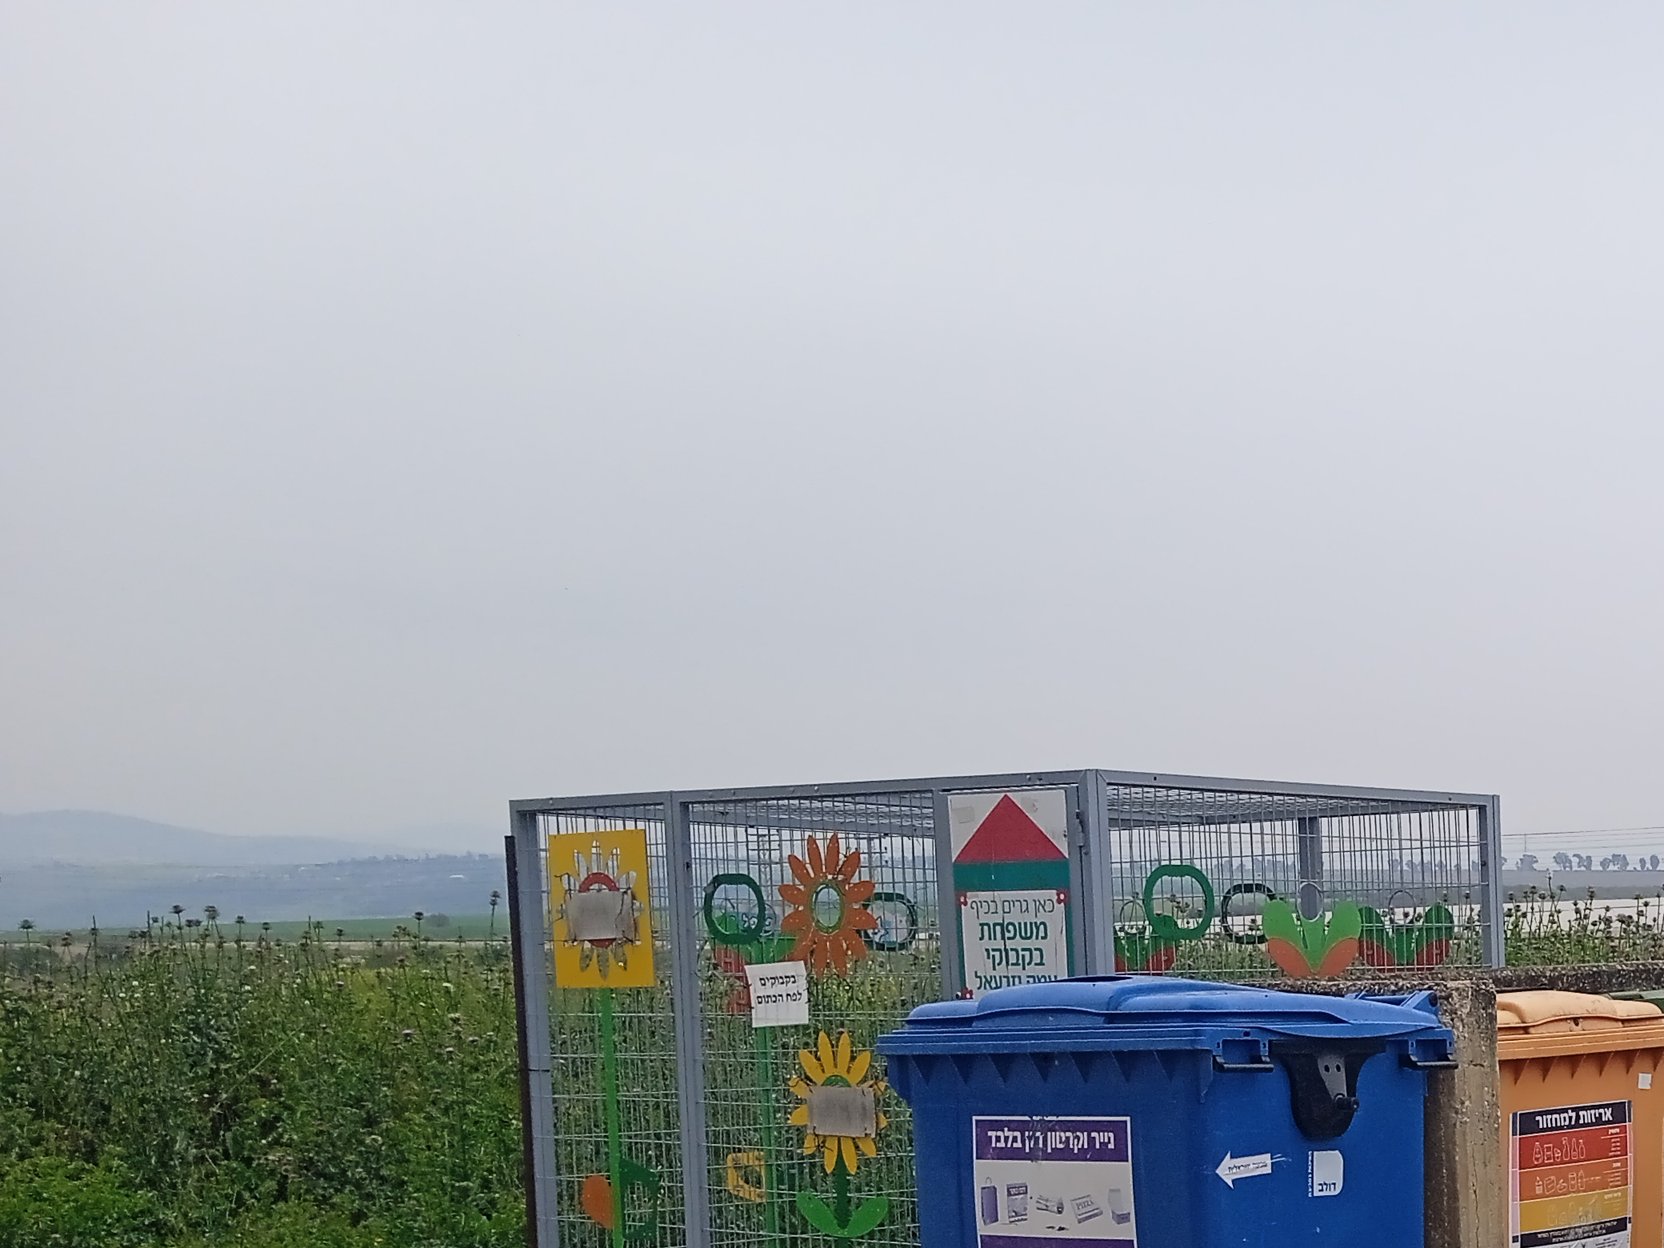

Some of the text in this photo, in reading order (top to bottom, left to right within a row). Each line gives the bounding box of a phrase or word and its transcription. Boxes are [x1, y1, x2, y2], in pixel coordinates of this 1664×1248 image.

[970, 898, 1055, 920] כאן גרים בכיף
[979, 920, 1048, 941] משפחת
[985, 947, 1045, 971] בקבוקי
[759, 975, 797, 989] בקבוקים
[756, 990, 803, 1005] לפח הכתום
[1578, 1107, 1613, 1124] אריזות
[987, 1127, 1022, 1148] בלבד
[1047, 1131, 1088, 1154] וקרטון
[1090, 1131, 1115, 1149] נייר
[1317, 1181, 1337, 1192] דולב
